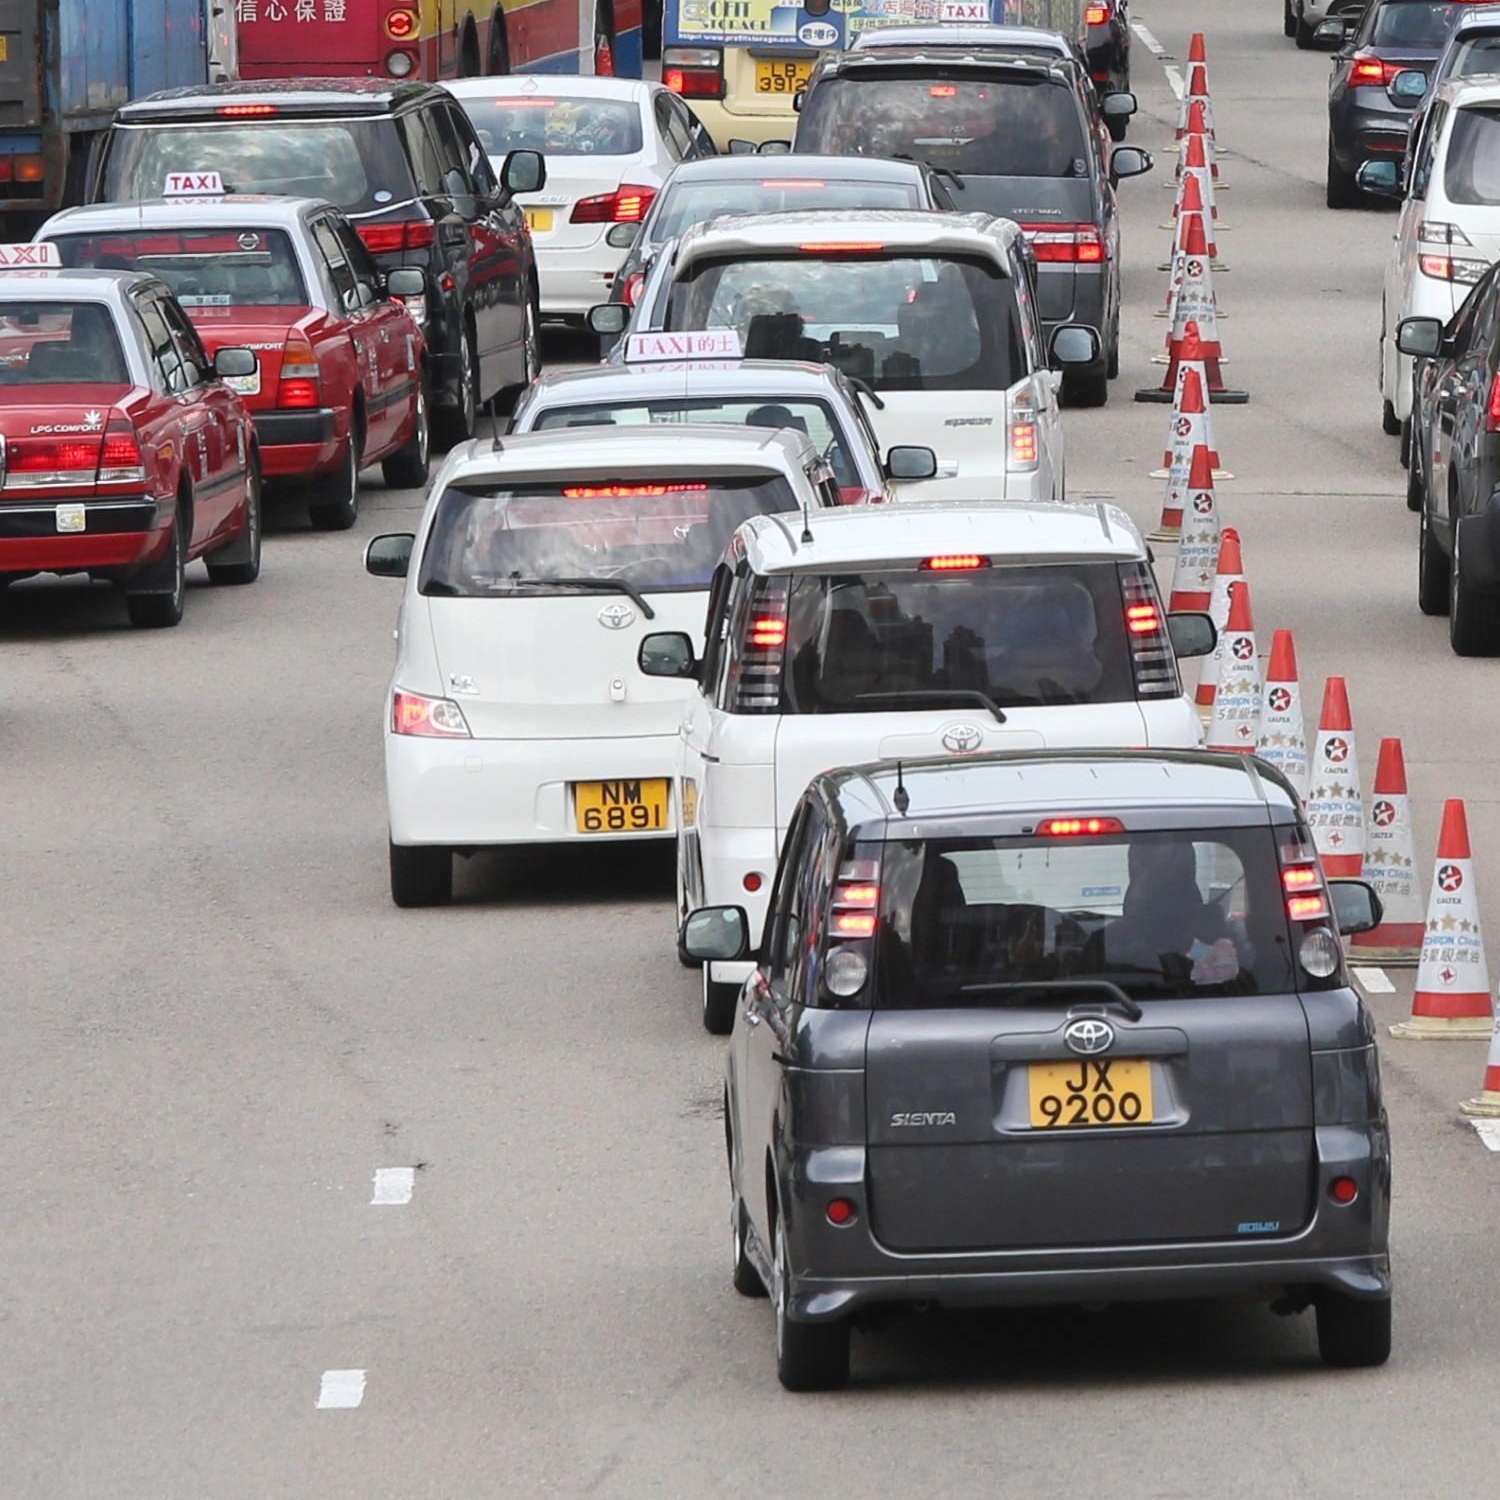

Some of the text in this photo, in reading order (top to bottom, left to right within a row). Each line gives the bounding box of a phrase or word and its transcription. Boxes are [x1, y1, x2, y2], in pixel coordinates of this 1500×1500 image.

[946, 6, 985, 19] TAXI
[771, 63, 796, 79] LB
[170, 175, 218, 190] TAXI
[634, 335, 735, 356] TAXI 的士
[31, 423, 103, 434] LPG COMFORT
[601, 781, 641, 805] NM
[583, 806, 661, 829] 6891
[1436, 897, 1462, 905] CALTEX
[1064, 1060, 1115, 1093] JX
[1039, 1092, 1143, 1126] 9200
[890, 1113, 957, 1128] SIENTA
